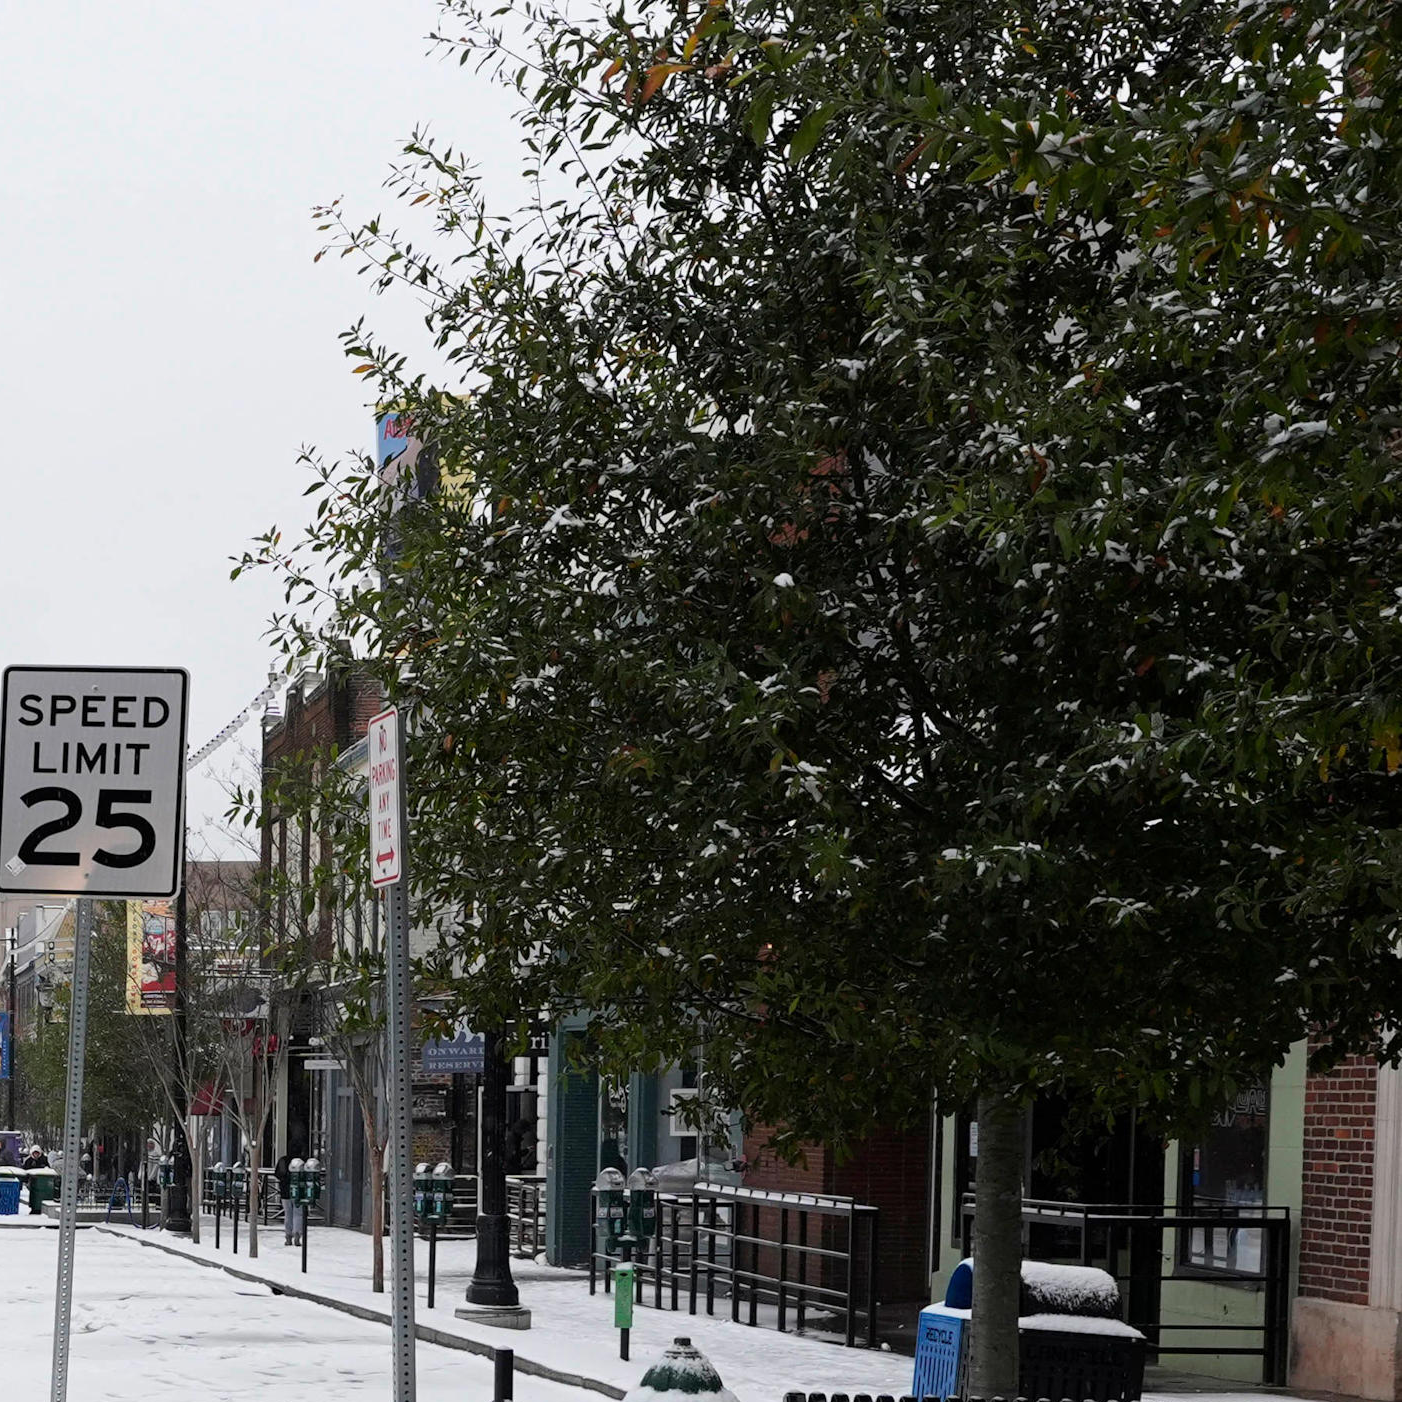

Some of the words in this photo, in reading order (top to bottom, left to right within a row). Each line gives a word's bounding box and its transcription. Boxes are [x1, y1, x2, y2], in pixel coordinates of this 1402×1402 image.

[18, 694, 170, 729] SPEED
[378, 729, 388, 753] NO
[33, 743, 150, 775] LIMIT
[371, 758, 396, 790] PARKING
[378, 791, 390, 814] ANY
[17, 787, 156, 869] 25
[377, 817, 392, 842] TIME
[926, 1327, 954, 1345] RECYCLE
[1027, 1344, 1124, 1367] LANDFILL
